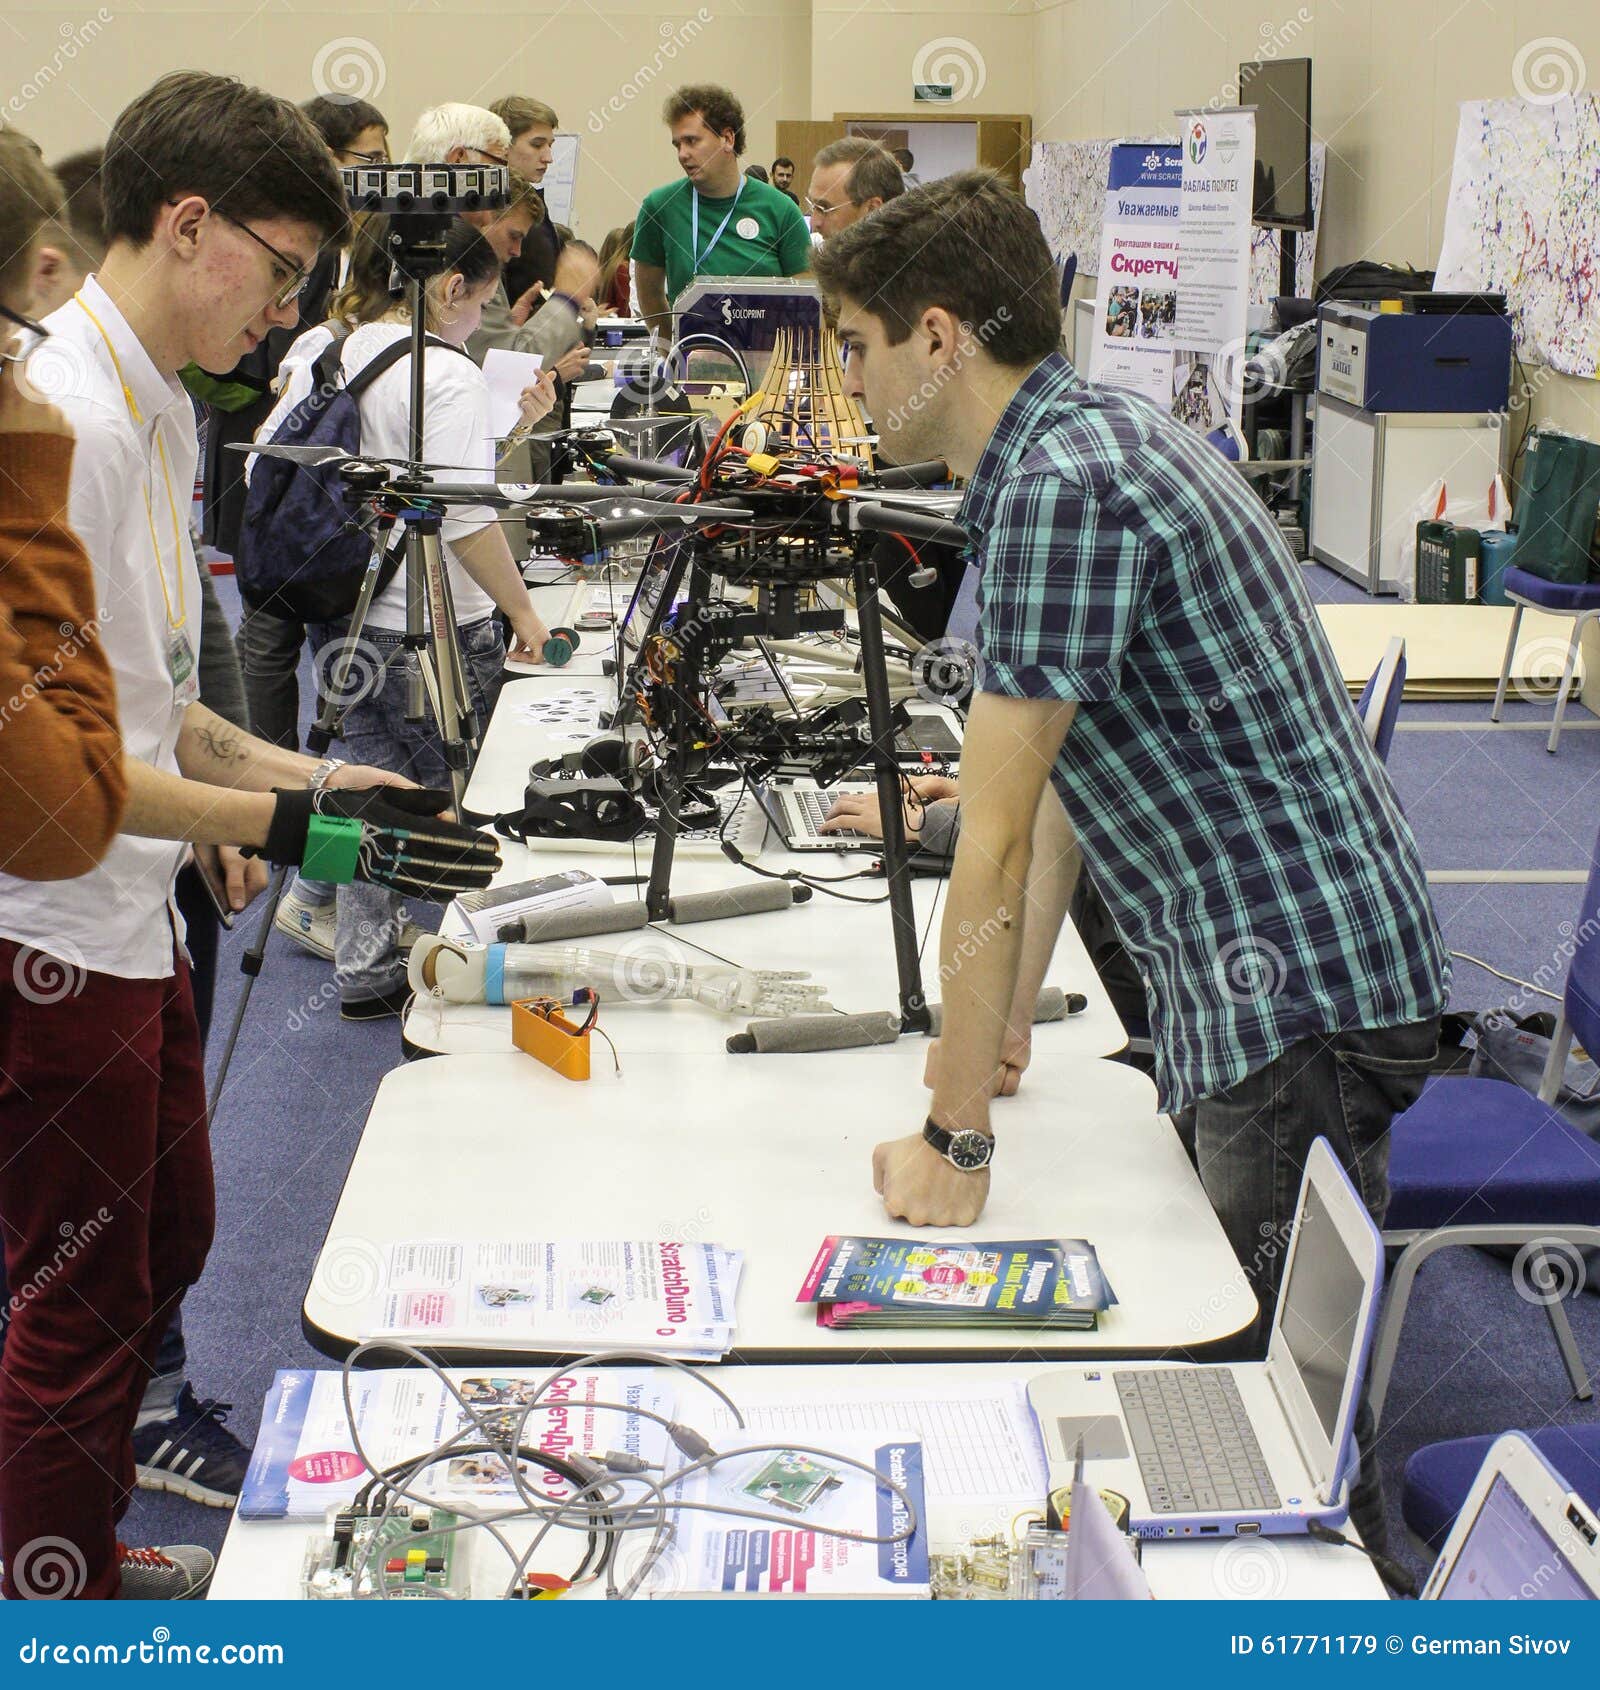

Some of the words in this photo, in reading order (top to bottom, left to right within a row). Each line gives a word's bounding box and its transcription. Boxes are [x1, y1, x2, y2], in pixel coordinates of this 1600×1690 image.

[1118, 201, 1179, 217] Уважаемые
[1113, 238, 1151, 249] Приглашаем
[1153, 240, 1173, 249] ваших
[732, 309, 766, 319] SOLOPRINT
[659, 1241, 692, 1323] ScratchDuino
[1004, 1264, 1029, 1284] Linux
[996, 1284, 1023, 1309] Format
[626, 1384, 644, 1432] Уважмые
